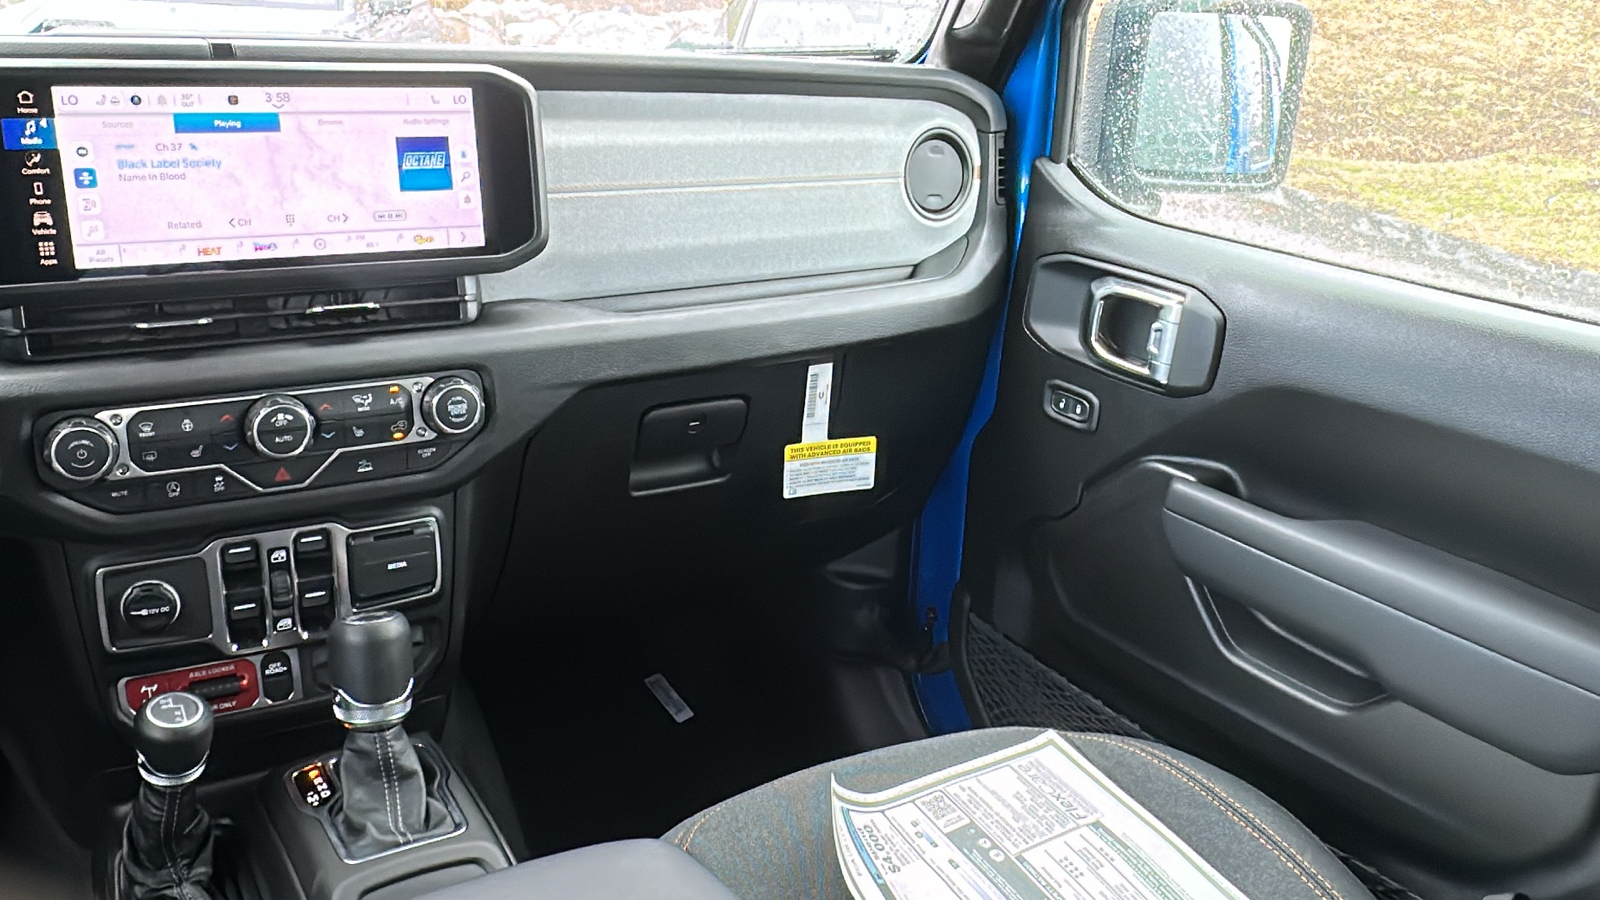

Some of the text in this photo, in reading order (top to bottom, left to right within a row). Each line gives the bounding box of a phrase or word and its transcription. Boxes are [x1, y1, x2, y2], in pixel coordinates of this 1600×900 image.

[61, 94, 78, 106] LO
[453, 94, 467, 104] LO
[17, 106, 38, 114] Home
[102, 120, 133, 129] Sources
[213, 119, 242, 129] Playing
[155, 142, 182, 152] Ch 37
[117, 157, 222, 170] Black Label Society
[403, 152, 445, 168] OCTANE
[21, 166, 51, 176] Comfort
[118, 172, 147, 182] Name
[159, 172, 187, 181] Blood
[29, 197, 51, 206] Phone
[237, 218, 252, 227] CH
[327, 214, 341, 223] CH
[167, 220, 203, 230] Related
[31, 227, 57, 236] Vehicle
[197, 246, 222, 257] HEAT
[40, 257, 58, 267] Apps
[275, 419, 289, 427] OFF
[275, 435, 293, 443] AUTO
[806, 444, 832, 452] VEHICLE
[840, 441, 872, 449] EQUIPPED
[790, 452, 806, 460] WITH
[807, 449, 841, 458] ADVANCED
[387, 561, 408, 570] MEDIA
[269, 661, 281, 670] OFF
[188, 663, 236, 679] AXLE LOCKER
[219, 700, 237, 710] ONLY
[320, 790, 331, 799] D
[1017, 766, 1087, 821] FlexCare
[863, 826, 900, 873] $4,000
